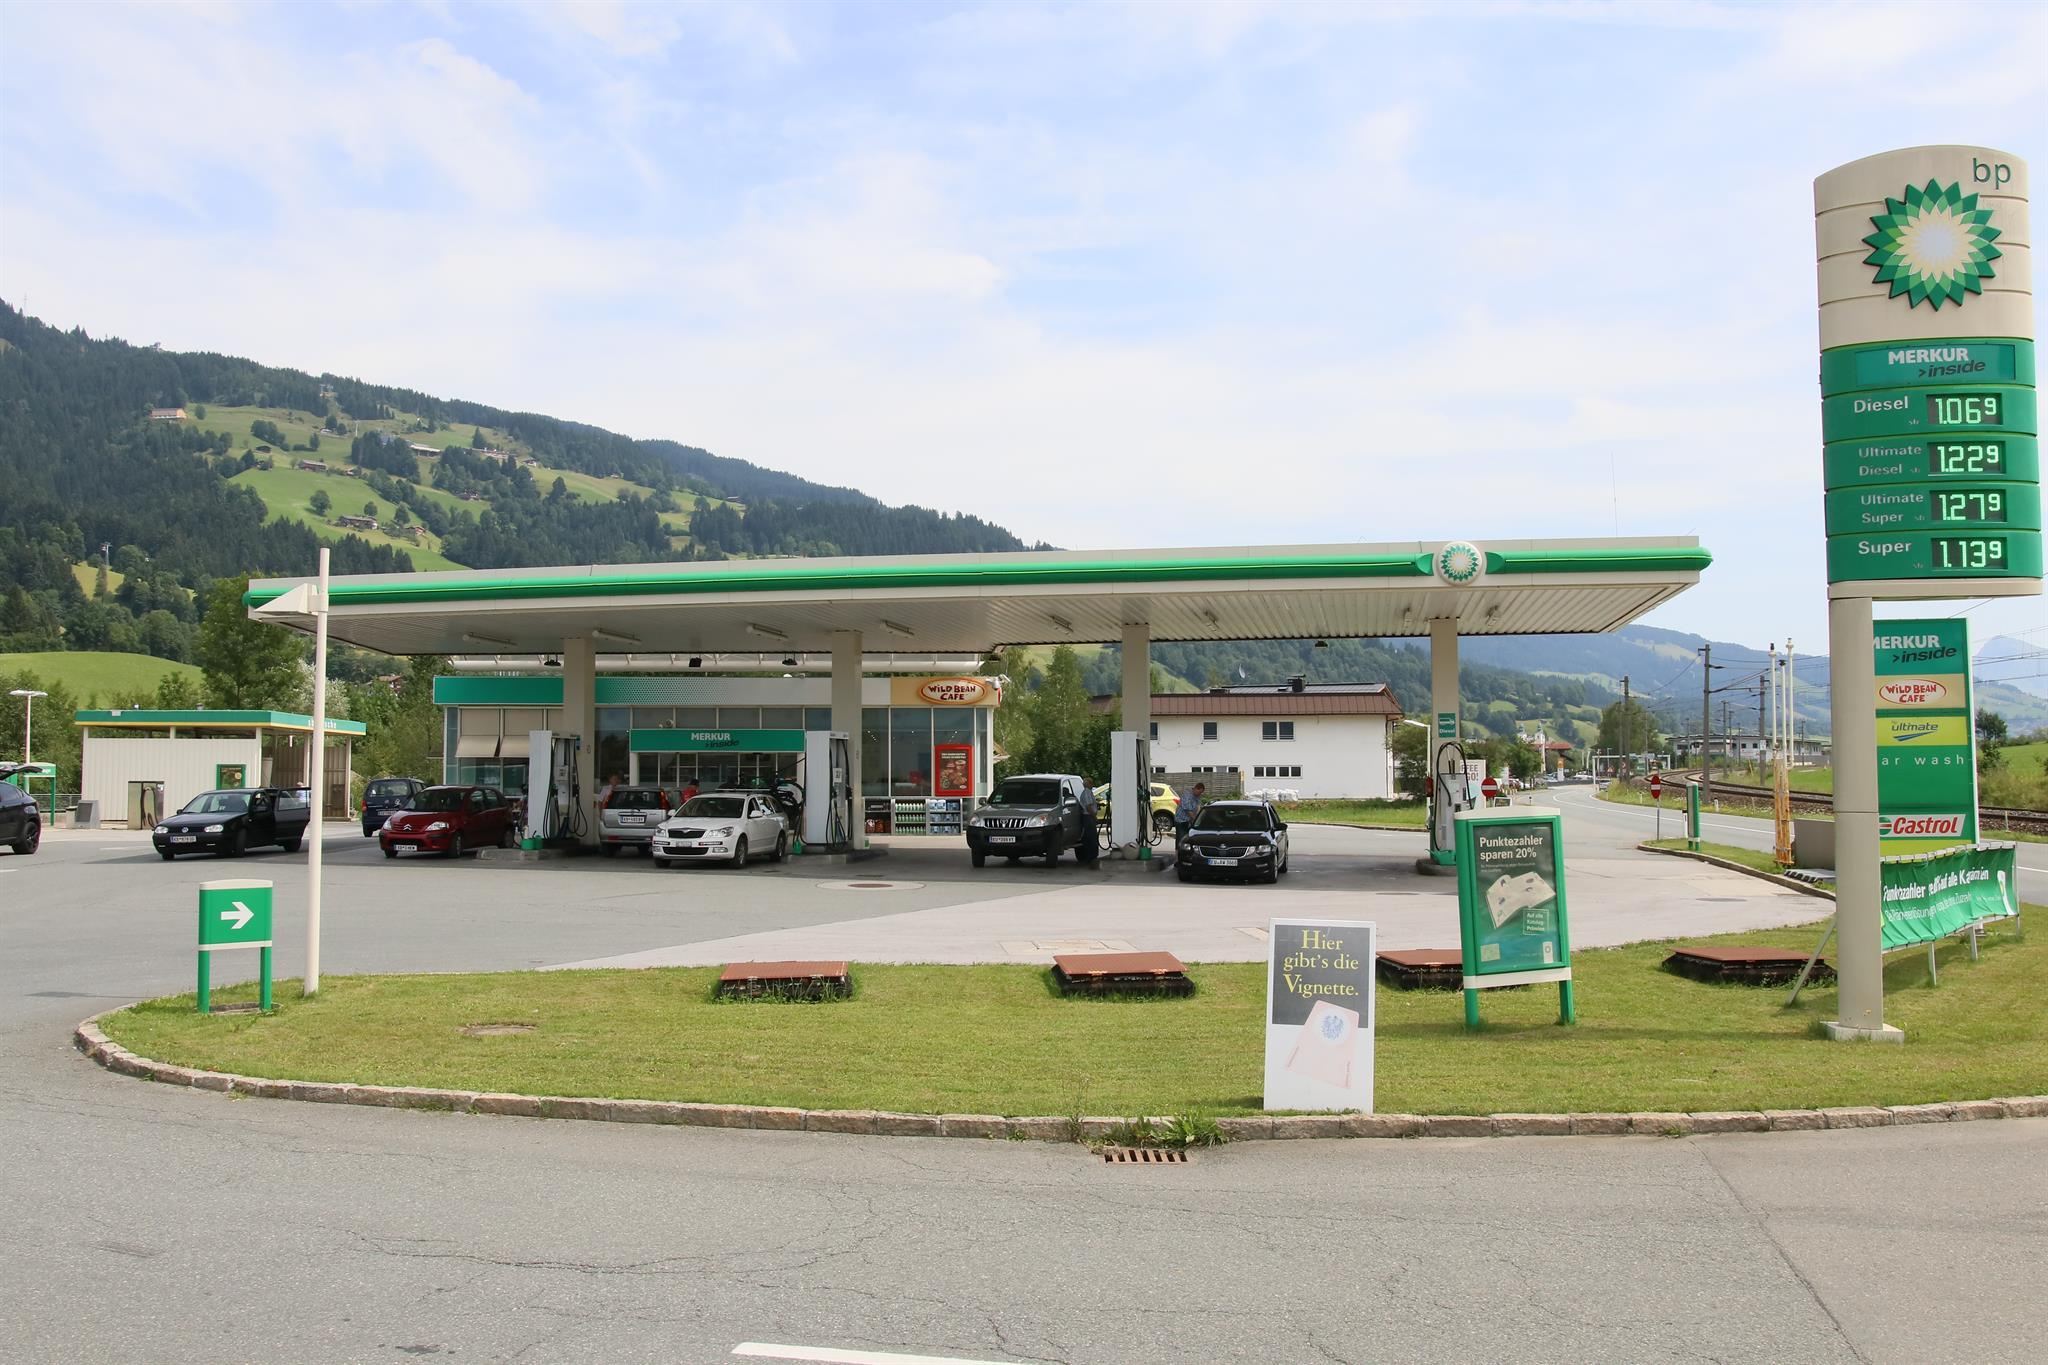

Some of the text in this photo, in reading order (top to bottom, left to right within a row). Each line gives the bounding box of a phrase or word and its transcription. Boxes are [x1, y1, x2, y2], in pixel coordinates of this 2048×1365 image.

[1972, 157, 2012, 190] bp
[1888, 347, 1969, 365] MERKUR
[1854, 396, 1909, 413] Diesel
[1858, 445, 1922, 458] Ultimate
[1859, 464, 1903, 477] Diesel
[1860, 493, 1924, 505] Ultimate
[1861, 512, 1904, 525] Super
[1858, 540, 1912, 556] Super
[953, 684, 976, 693] BEAN
[1913, 684, 1937, 694] BEAN
[940, 693, 964, 701] CAFE
[1899, 694, 1925, 703] CAFE
[1891, 722, 1939, 731] ultimate
[691, 732, 731, 741] MERKUR
[1881, 754, 1965, 766] ar wash
[1893, 816, 1959, 834] Castrol
[1479, 834, 1544, 848] Punktezahler
[1480, 847, 1537, 862] sparen 20%
[1301, 929, 1344, 950] Hier
[1333, 953, 1359, 970] die
[1283, 973, 1360, 998] Vignette.
